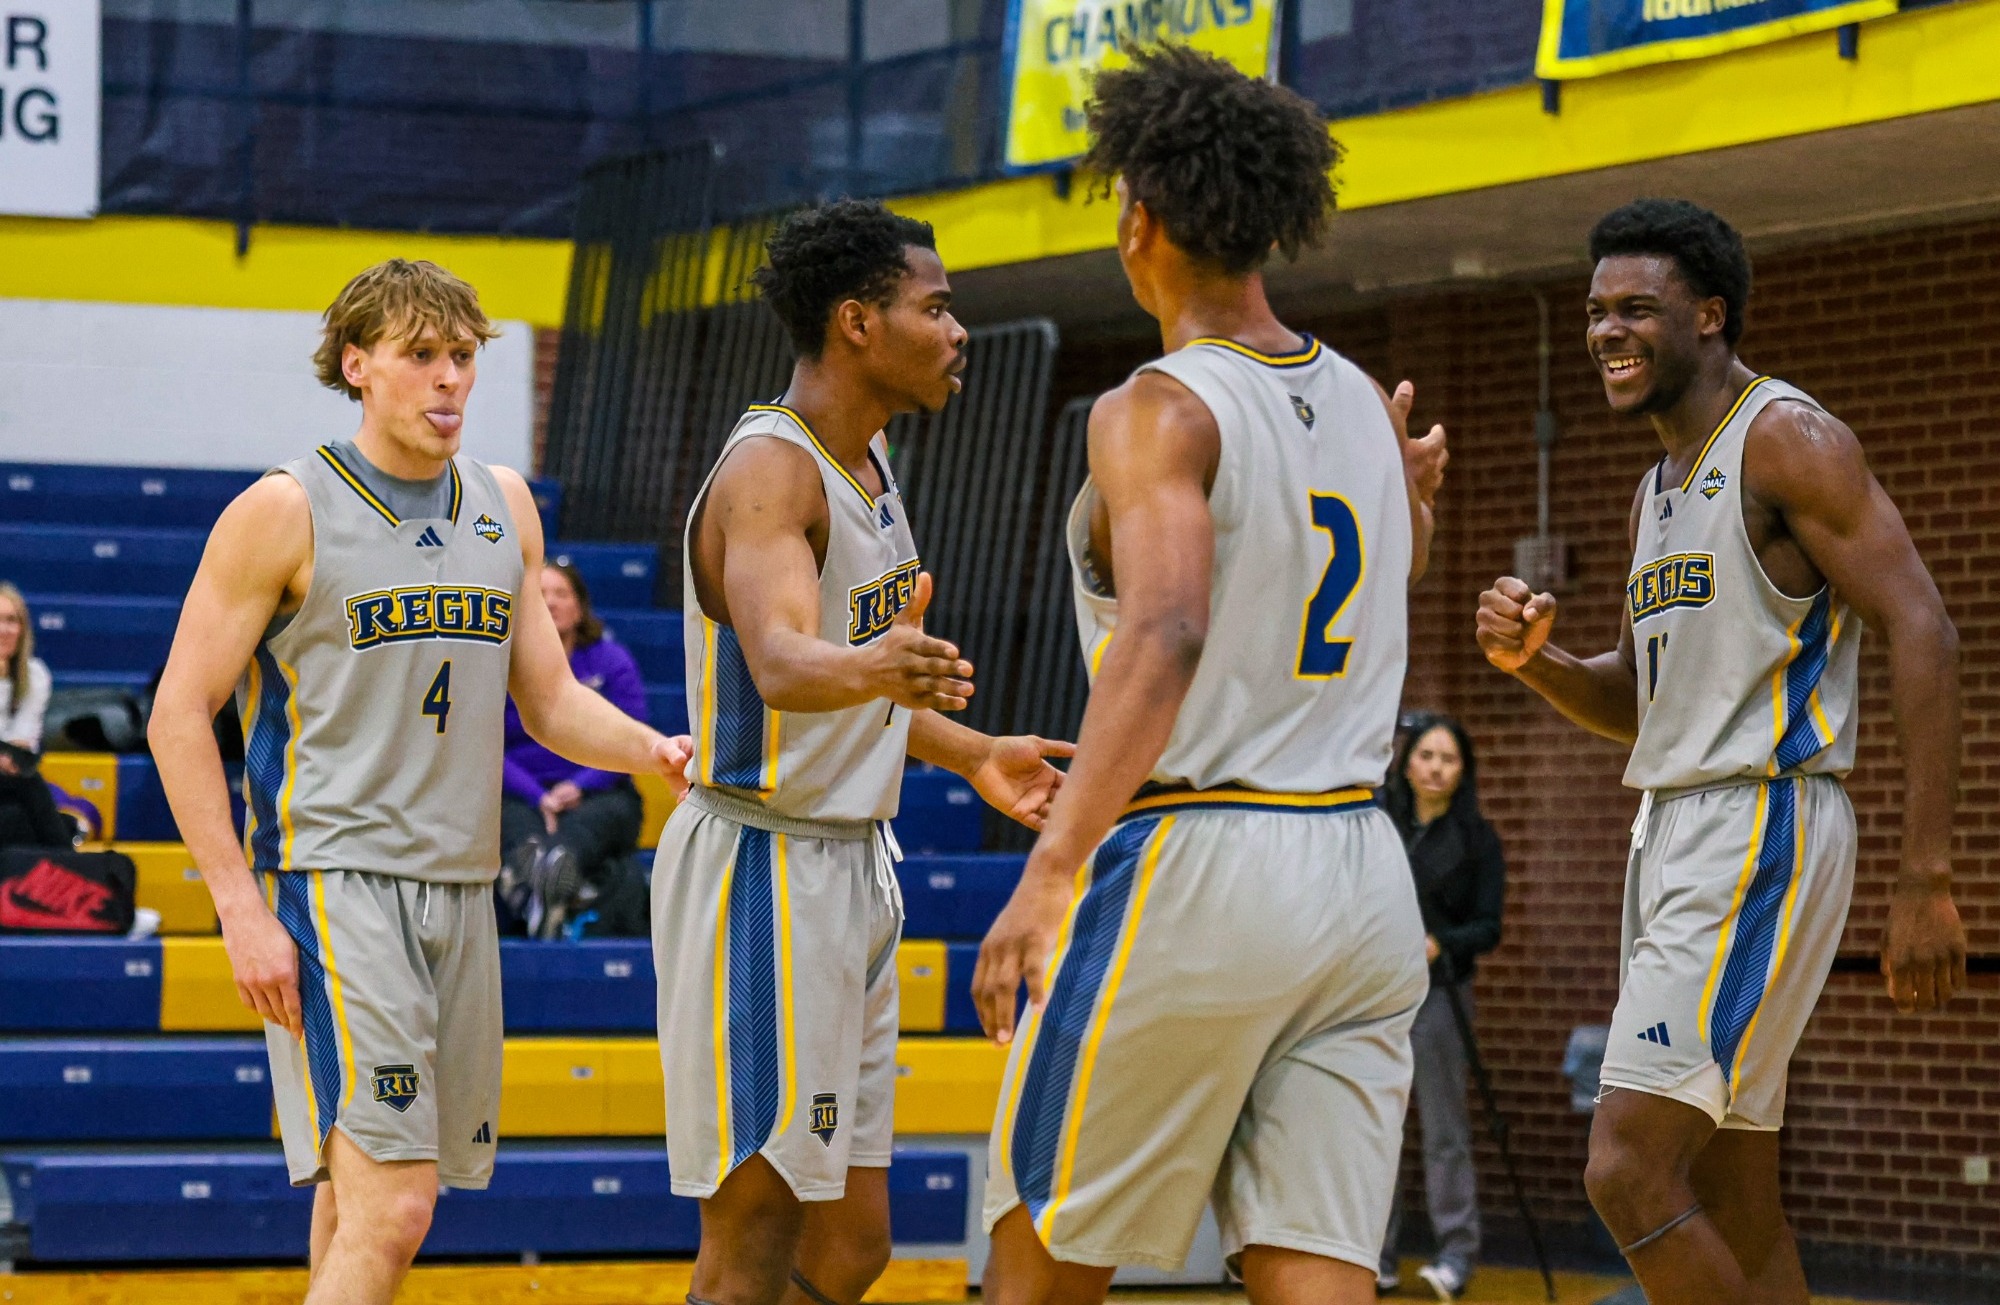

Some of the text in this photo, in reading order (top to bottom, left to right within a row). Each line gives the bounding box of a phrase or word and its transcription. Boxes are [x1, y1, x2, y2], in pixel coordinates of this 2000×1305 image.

[0, 87, 59, 142] G
[1701, 477, 1725, 491] RMAC
[474, 522, 504, 536] RMAC
[1293, 488, 1366, 681] 2
[347, 585, 512, 646] REGIS
[421, 658, 451, 734] 4
[371, 1073, 419, 1100] RU
[810, 1104, 838, 1131] RU
